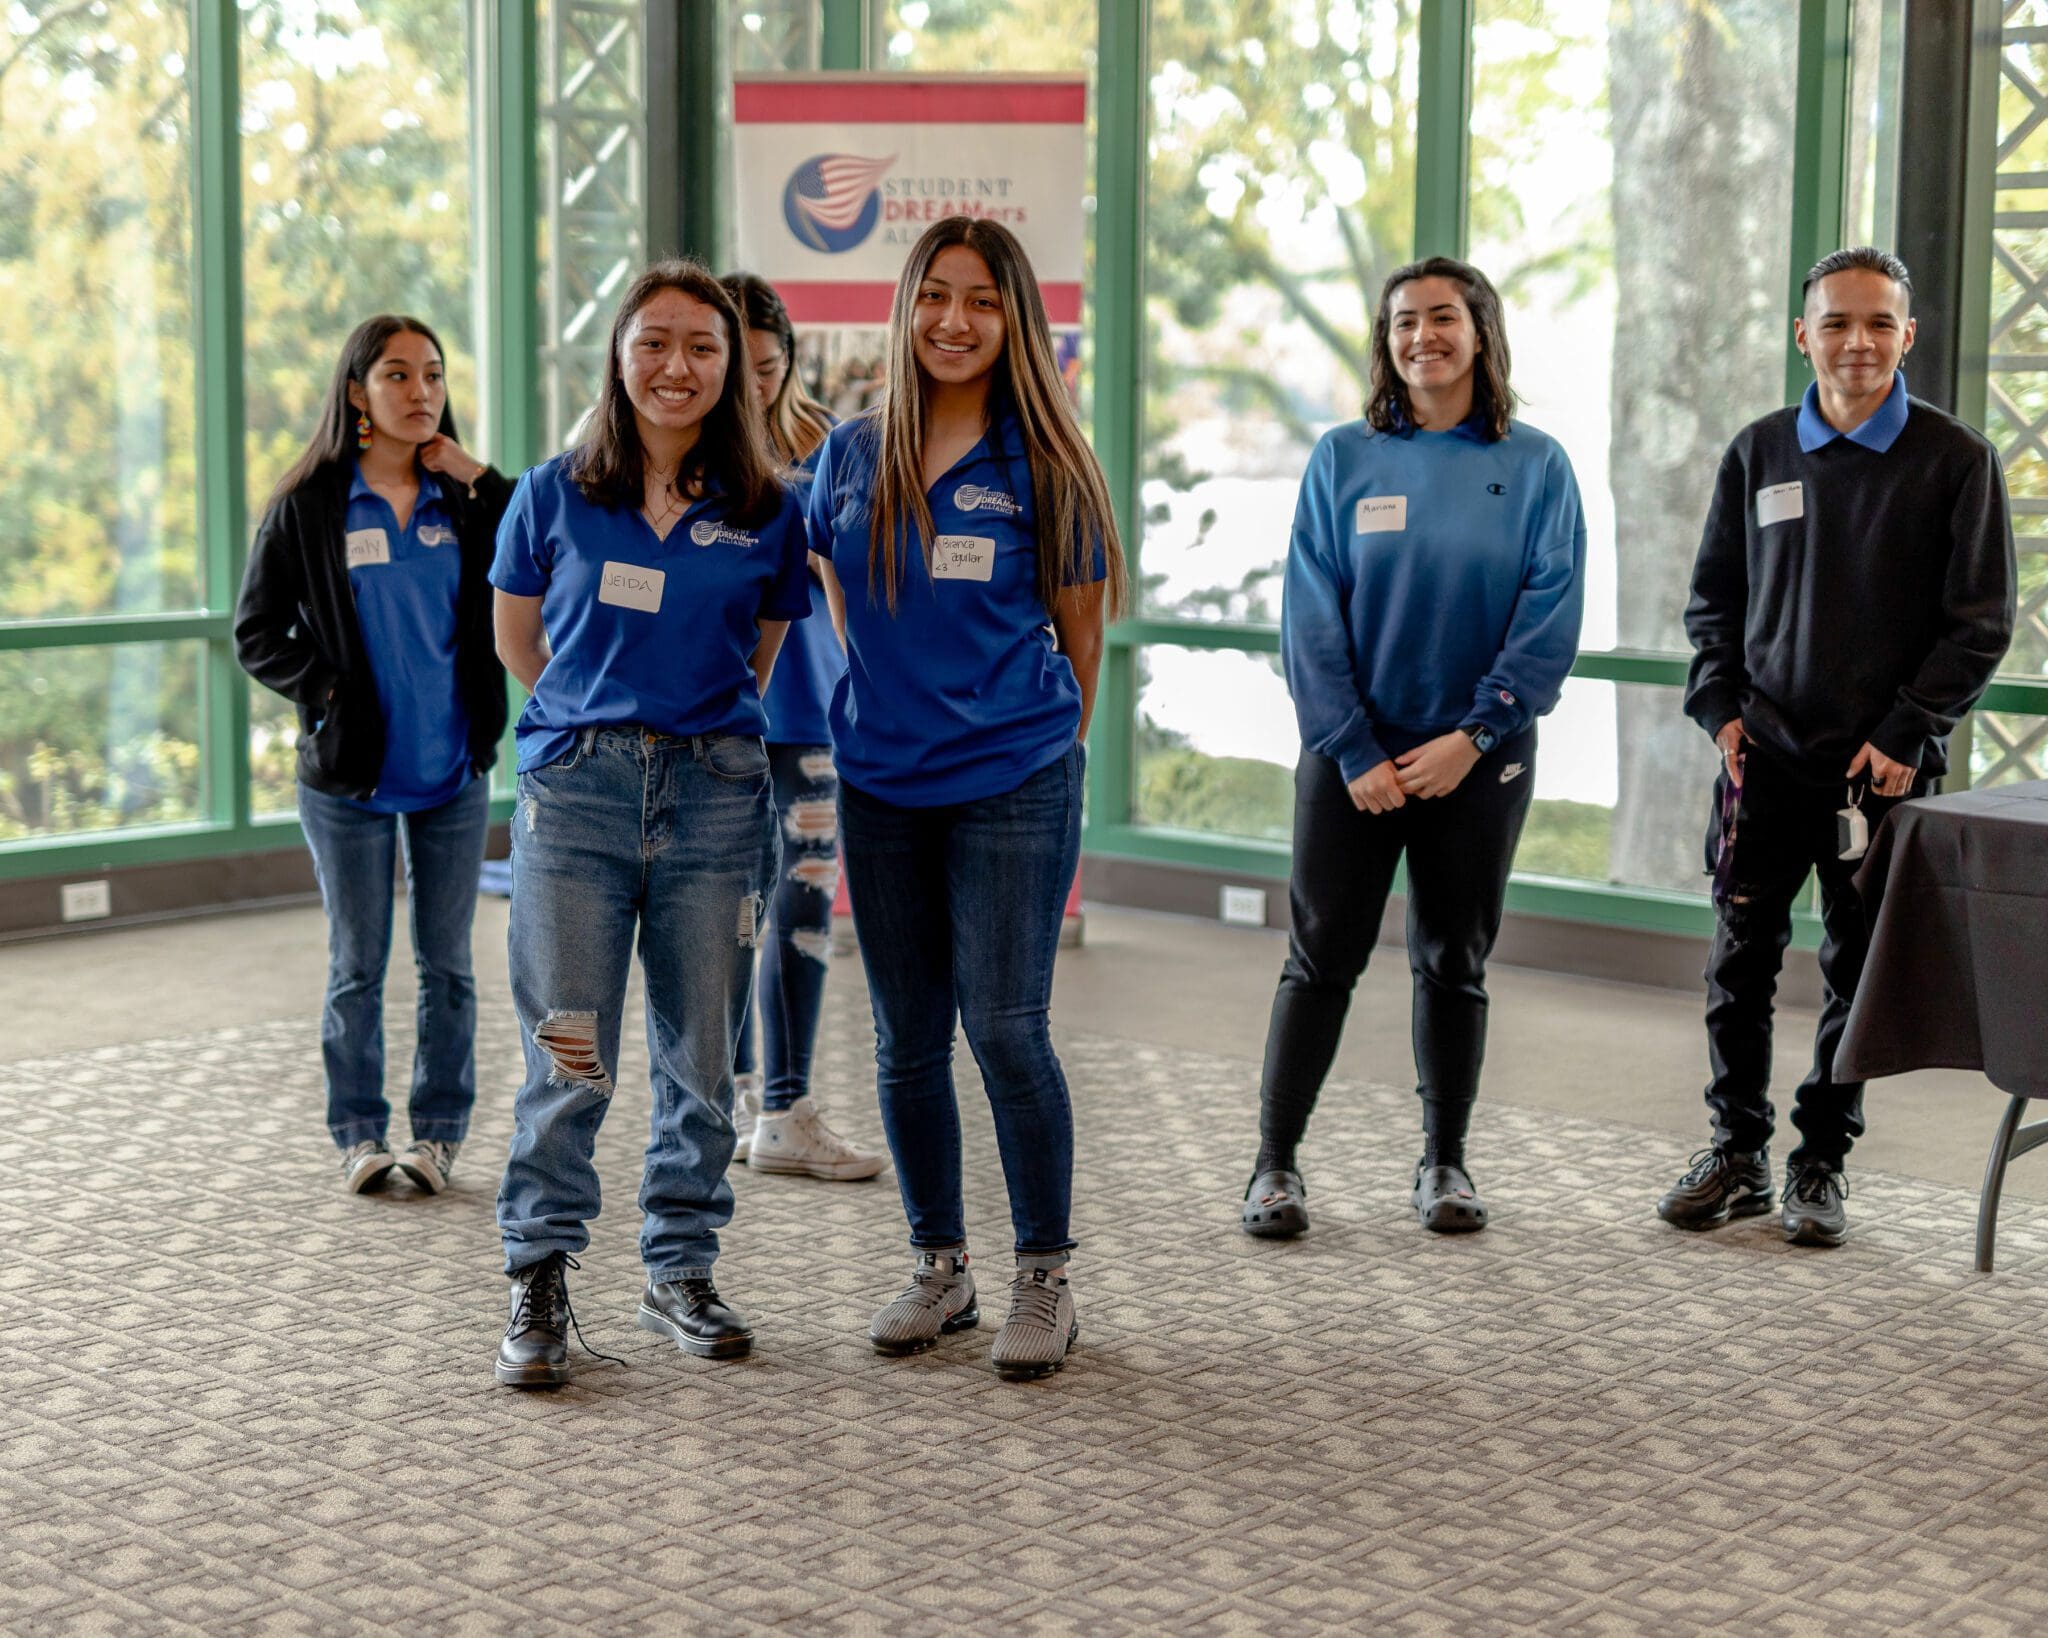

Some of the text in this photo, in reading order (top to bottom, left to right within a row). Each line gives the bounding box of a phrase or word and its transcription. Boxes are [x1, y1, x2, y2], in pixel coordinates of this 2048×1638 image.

[884, 177, 1013, 197] STUDENT
[885, 199, 1027, 222] DREAMers
[718, 524, 751, 535] STUDENT
[718, 530, 759, 544] DREAMers
[347, 537, 380, 558] mily
[717, 537, 752, 548] ALLIANCE
[942, 537, 975, 549] Bianca
[603, 572, 652, 593] NEIDA
